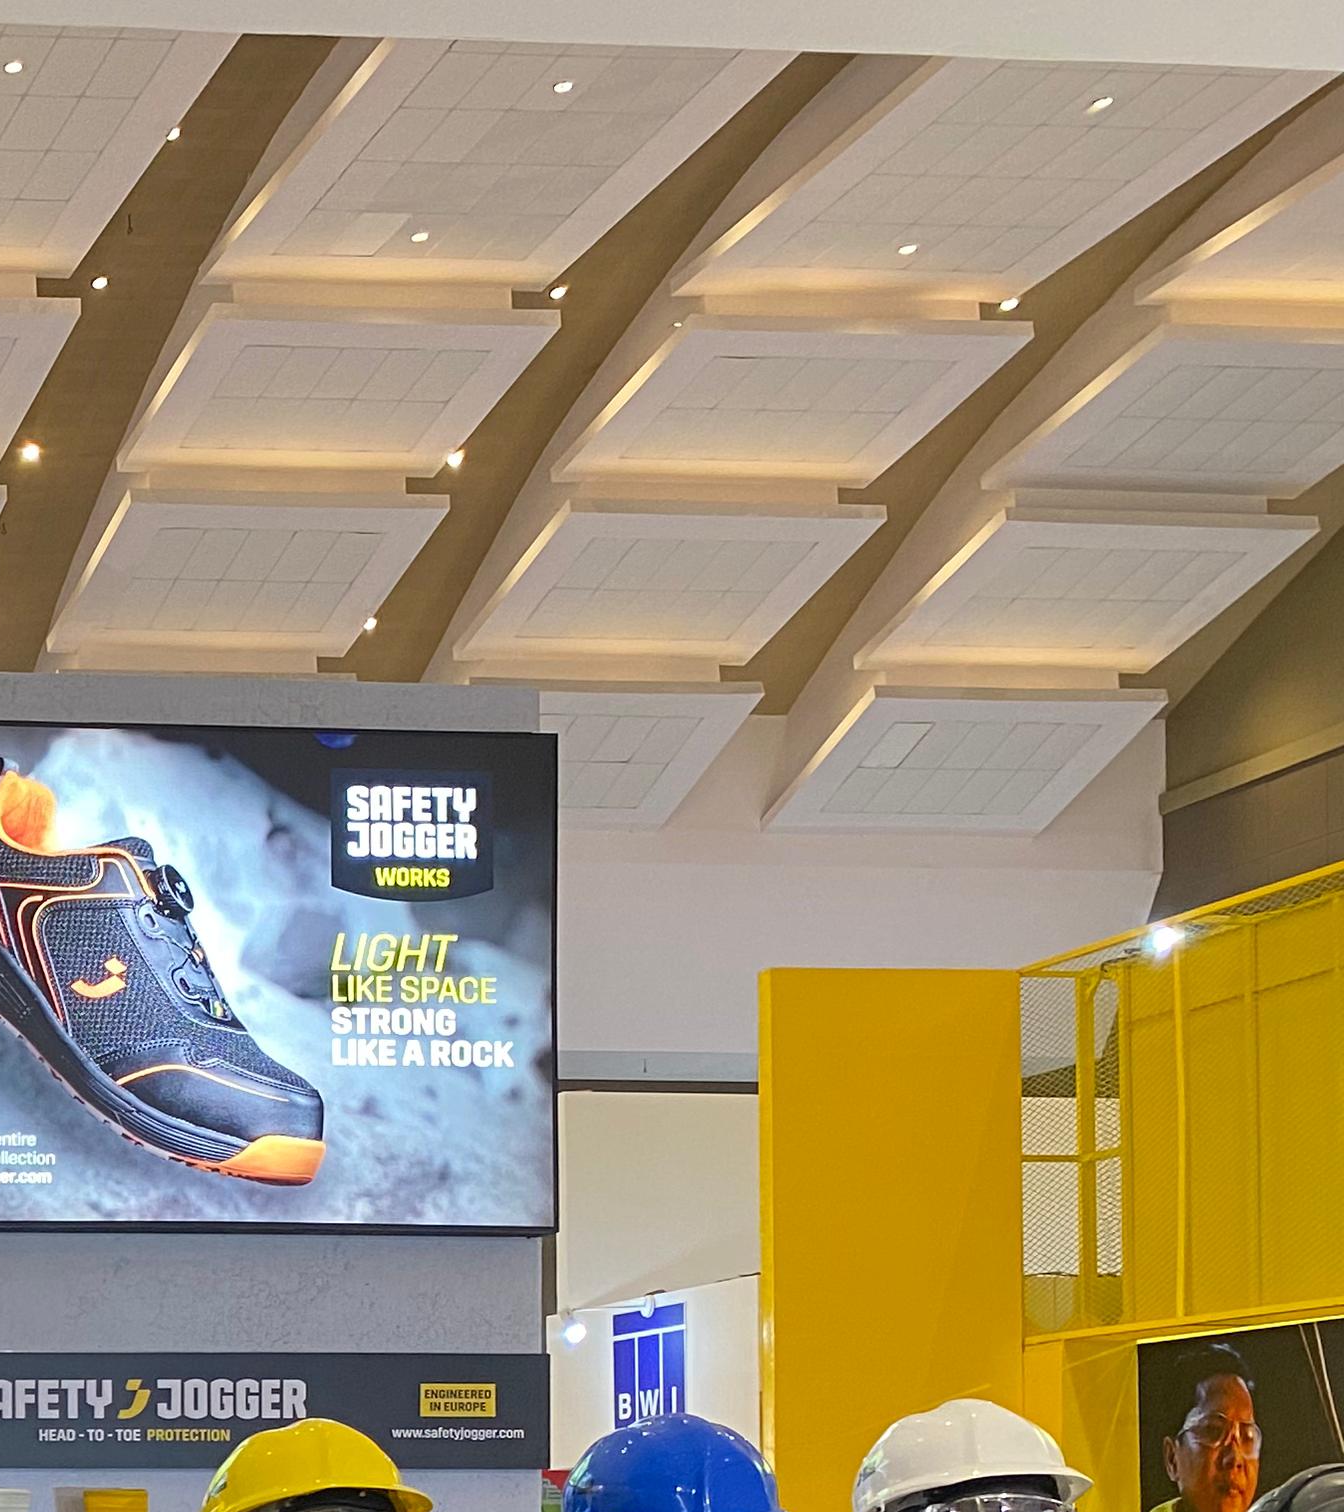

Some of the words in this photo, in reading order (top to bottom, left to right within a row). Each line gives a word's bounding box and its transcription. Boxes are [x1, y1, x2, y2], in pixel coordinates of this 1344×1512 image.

[346, 785, 477, 822] SAFETY
[346, 822, 478, 859] JOGGER
[375, 867, 450, 887] WORKS
[331, 932, 458, 973] LIGHT
[332, 974, 393, 1003] LIKE
[400, 976, 497, 1005] SPACE
[331, 1007, 456, 1036] STRONG
[332, 1038, 397, 1067] LIKE
[402, 1039, 425, 1067] A
[430, 1040, 514, 1068] ROCK
[156, 1378, 307, 1420] JOGGER
[424, 1389, 492, 1400] ENGINEERED
[429, 1401, 441, 1412] IN
[443, 1401, 487, 1413] EUROPE
[147, 1429, 230, 1442] PROTECTION
[392, 1427, 524, 1441] www.safetyjogger.com
